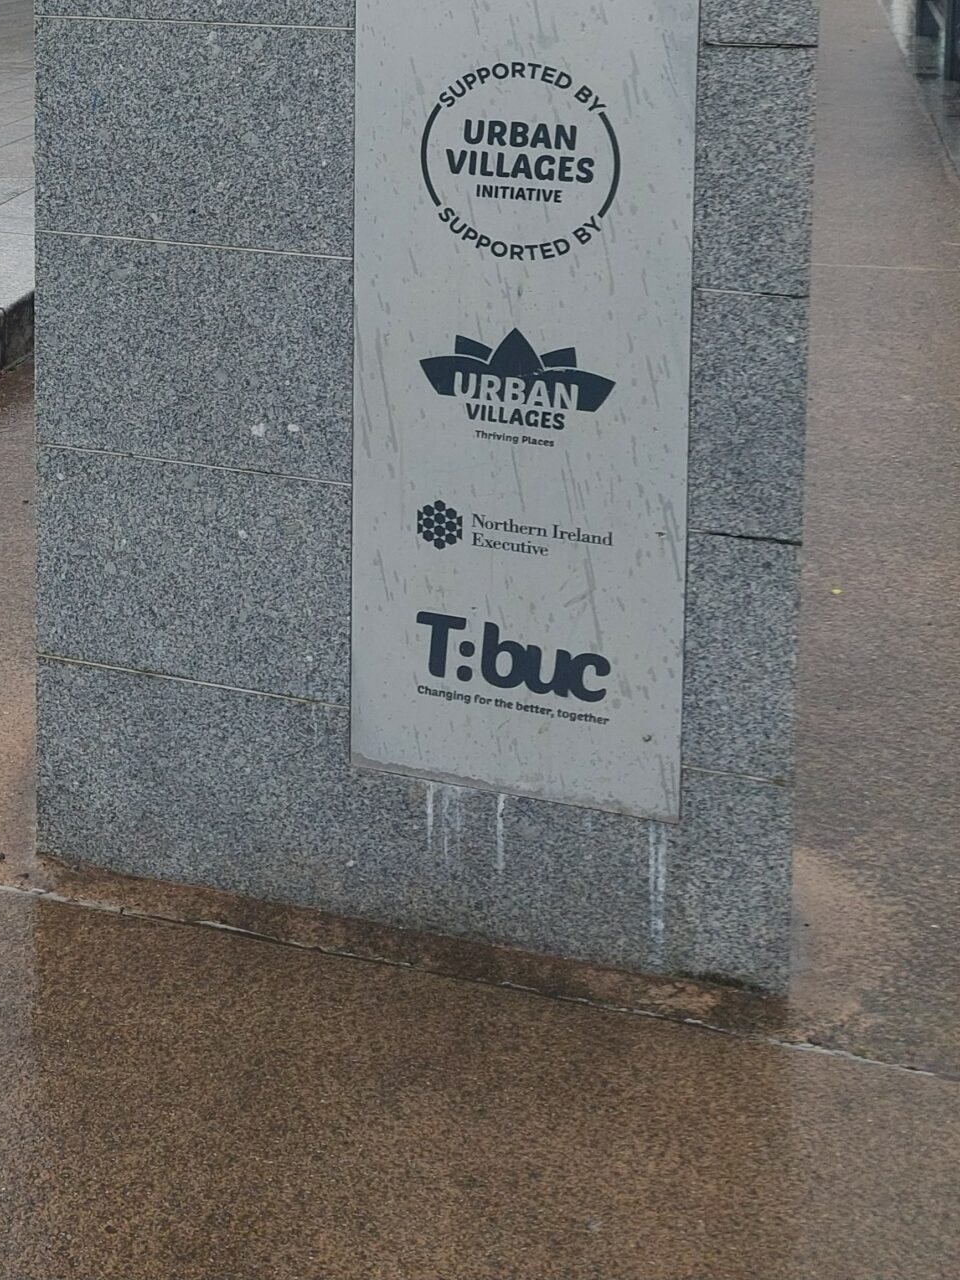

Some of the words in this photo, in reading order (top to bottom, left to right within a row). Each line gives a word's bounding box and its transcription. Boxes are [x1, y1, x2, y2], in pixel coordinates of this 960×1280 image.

[438, 61, 573, 108] SUPPORTED
[574, 85, 607, 113] BY
[463, 118, 578, 151] URBAN
[446, 148, 596, 184] VILLAGES
[476, 184, 563, 203] INITIATIVE
[437, 207, 571, 261] SUPPORTED
[572, 216, 603, 245] BY
[452, 371, 579, 411] URBAN
[465, 402, 566, 431] VILLAGES
[475, 430, 519, 445] Thriving
[522, 435, 555, 448] Places
[471, 513, 548, 538] Northern
[552, 524, 614, 547] Ireland
[471, 532, 549, 557] Executive
[416, 610, 612, 703] T:buc
[417, 685, 472, 704] Changing
[474, 694, 493, 706] for
[494, 698, 514, 711] the
[516, 701, 555, 719] better,
[556, 707, 611, 726] together
